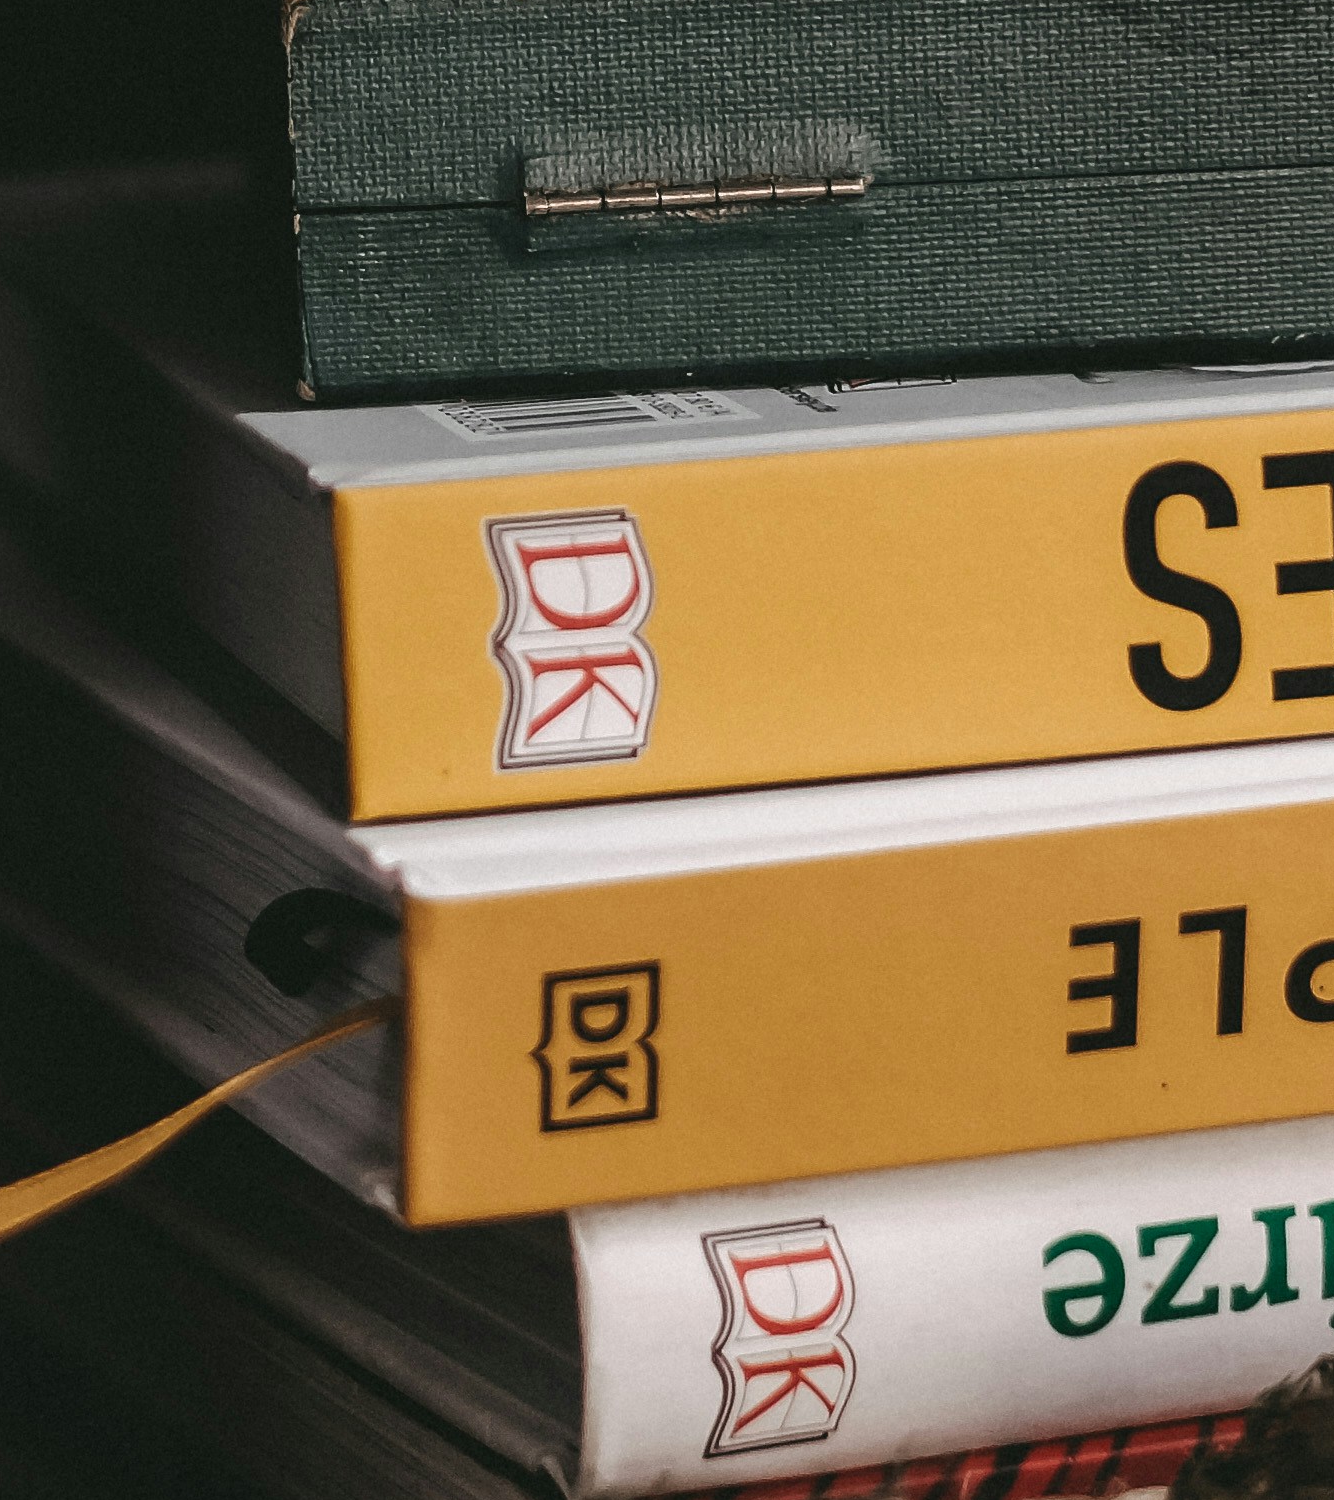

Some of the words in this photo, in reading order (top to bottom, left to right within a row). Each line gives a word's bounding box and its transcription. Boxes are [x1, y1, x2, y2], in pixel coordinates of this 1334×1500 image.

[518, 532, 643, 743] DK
[567, 986, 630, 1109] DK
[728, 1239, 846, 1439] DK
